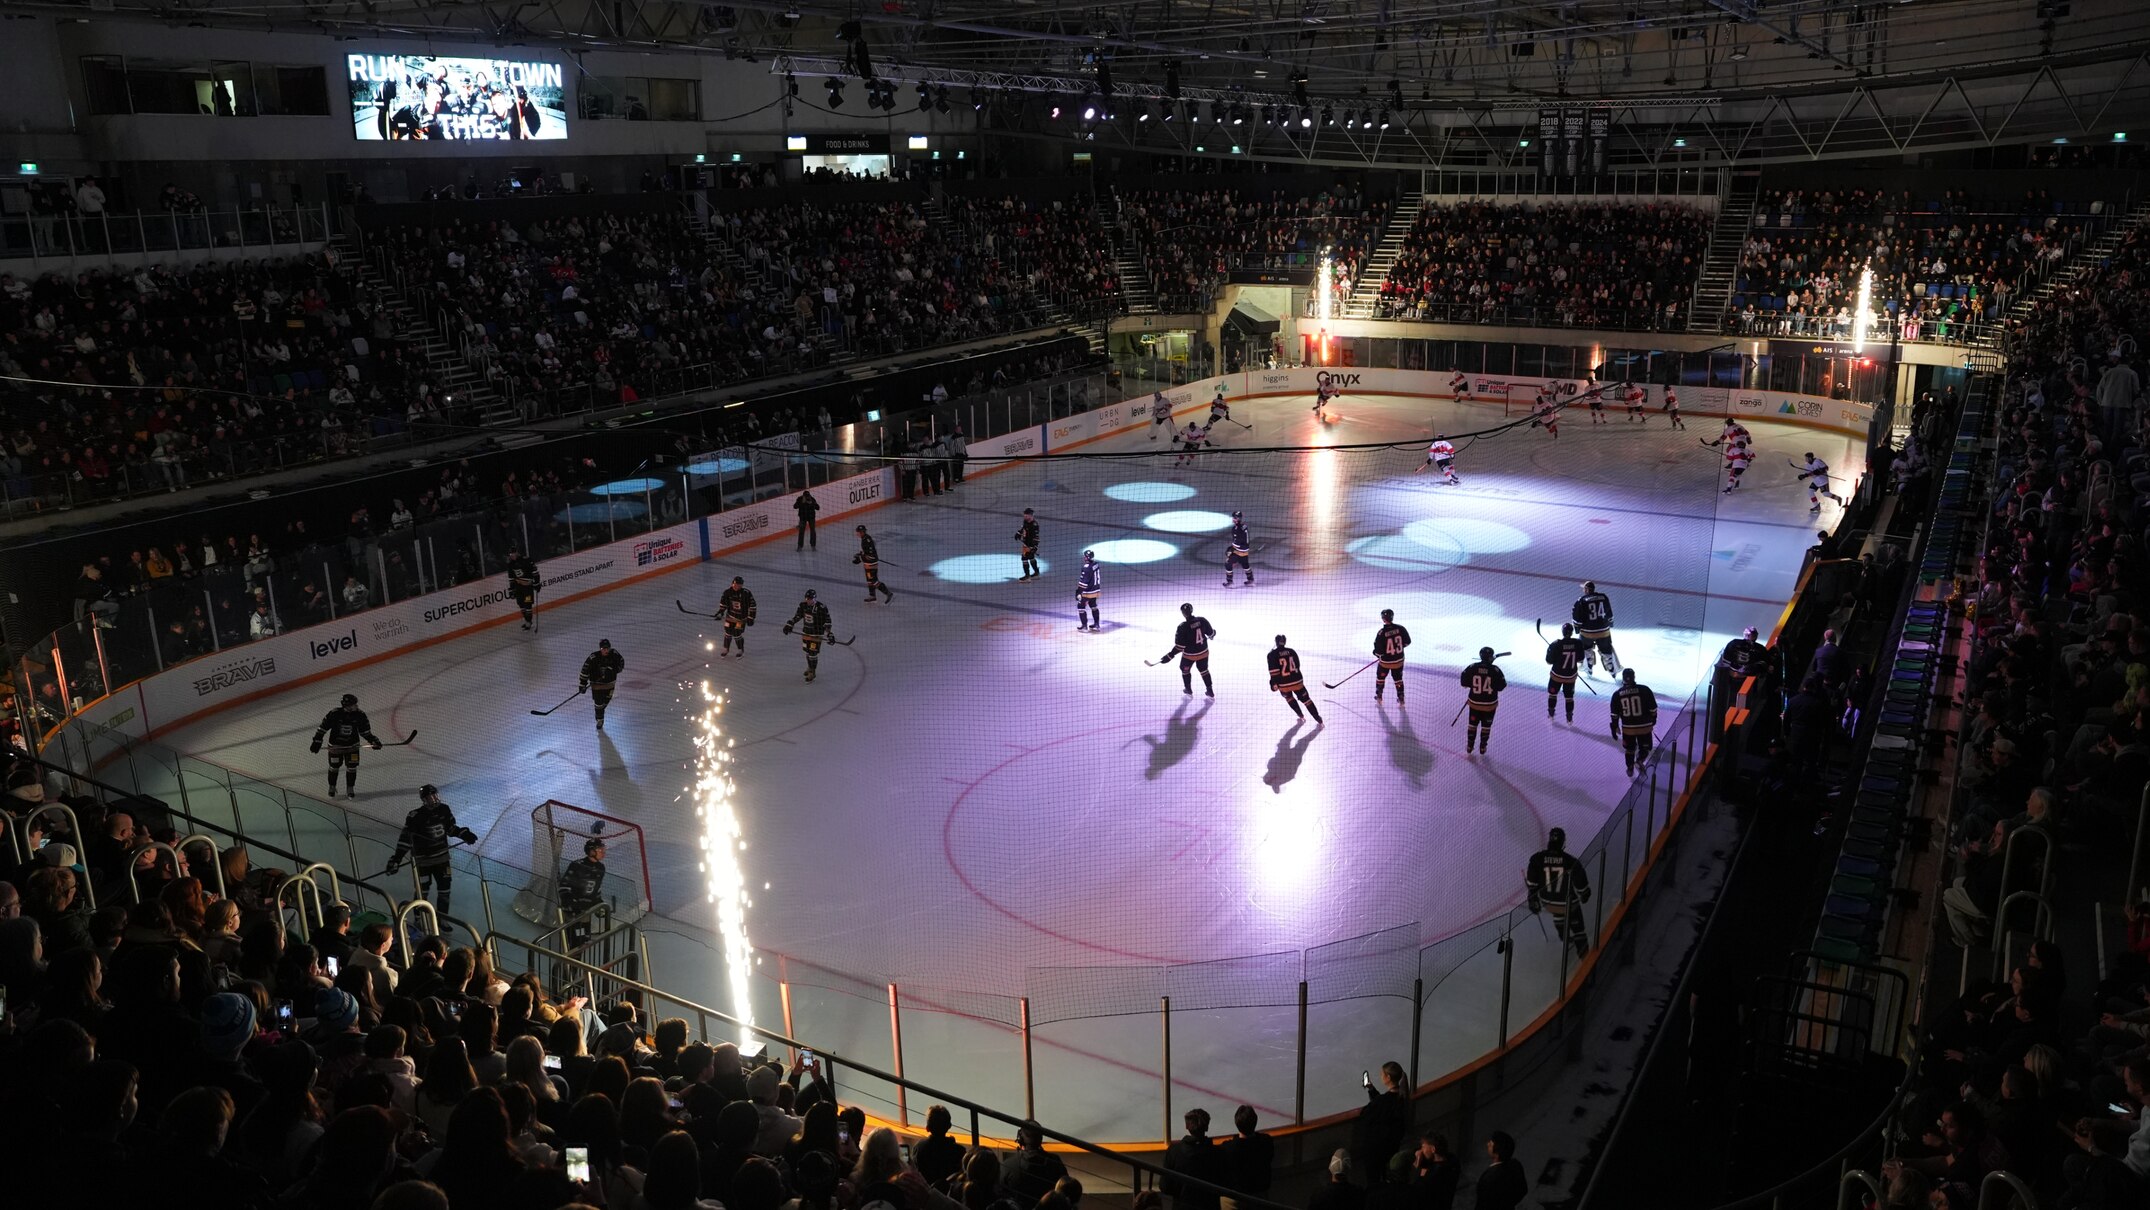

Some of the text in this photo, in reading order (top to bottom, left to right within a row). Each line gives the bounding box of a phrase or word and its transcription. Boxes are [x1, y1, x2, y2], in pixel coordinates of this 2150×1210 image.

[349, 55, 562, 87] RUN TOWN
[437, 114, 497, 139] THIS
[1564, 117, 1583, 125] 2022
[826, 141, 841, 149] FOOD
[848, 140, 870, 149] DRINKS
[1263, 374, 1289, 383] higgins
[1317, 371, 1360, 387] Onyx
[1131, 404, 1146, 417] level
[1739, 399, 1762, 407] zango
[1798, 401, 1823, 411] CORIN
[1099, 408, 1119, 420] URBN
[1797, 408, 1822, 418] FOREST
[849, 475, 880, 490] CANBERRA
[849, 484, 880, 504] OUTLET
[723, 514, 768, 538] BRAVE
[649, 538, 672, 550] Unique
[653, 541, 684, 556] BATTERIES
[658, 550, 678, 561] SOLAR
[424, 588, 515, 623] SUPERCURIOU
[548, 575, 573, 586] BRANDS
[574, 569, 594, 582] STAND
[595, 561, 614, 575] APART
[1588, 602, 1606, 620] 34
[388, 617, 401, 628] do
[375, 624, 409, 641] warmth
[1195, 628, 1204, 645] 4
[311, 630, 358, 660] level
[1386, 636, 1403, 656] 43
[1279, 656, 1298, 677] 24
[1561, 651, 1576, 669] 71
[193, 657, 276, 696] BRAVE
[1472, 675, 1494, 695] 94
[1620, 695, 1642, 717] 90
[1543, 866, 1565, 893] 17
